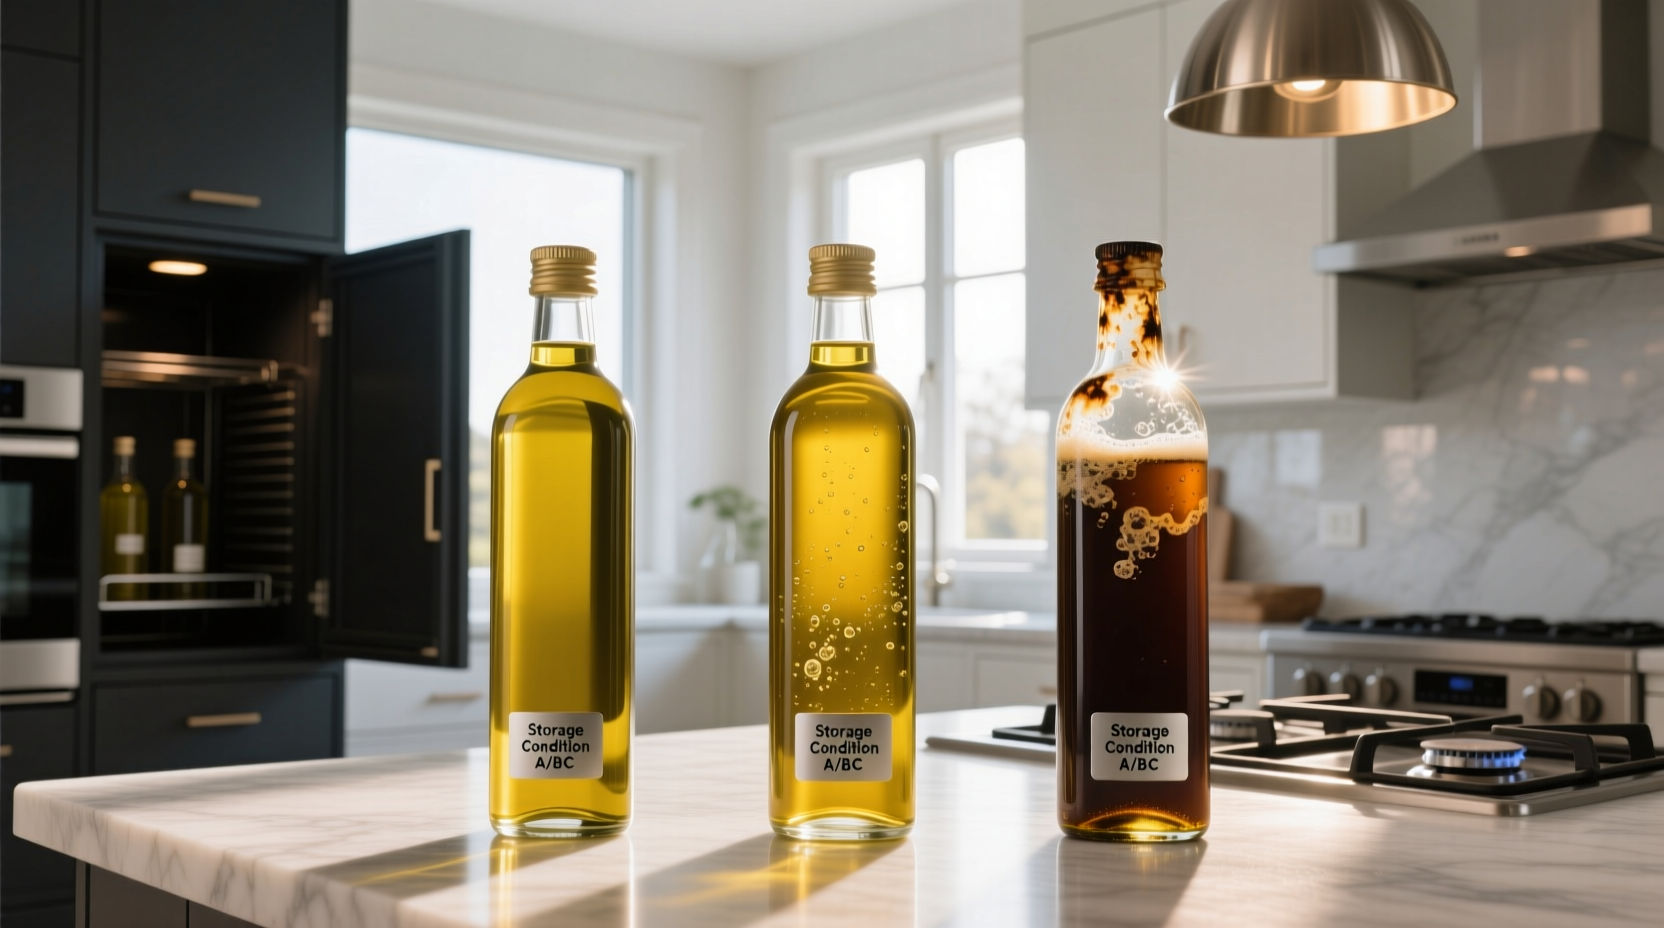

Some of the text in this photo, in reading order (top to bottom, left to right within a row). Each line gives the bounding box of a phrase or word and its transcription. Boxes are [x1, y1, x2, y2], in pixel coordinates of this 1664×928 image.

[528, 722, 584, 739] Storage
[815, 724, 872, 740] Storage
[1111, 723, 1169, 740] Storage
[521, 739, 590, 753] Condition
[810, 740, 879, 754] Condition
[1105, 740, 1174, 754] Condition
[535, 756, 574, 770] A/BC
[823, 757, 863, 772] A/BC
[1119, 757, 1159, 771] A/BC
